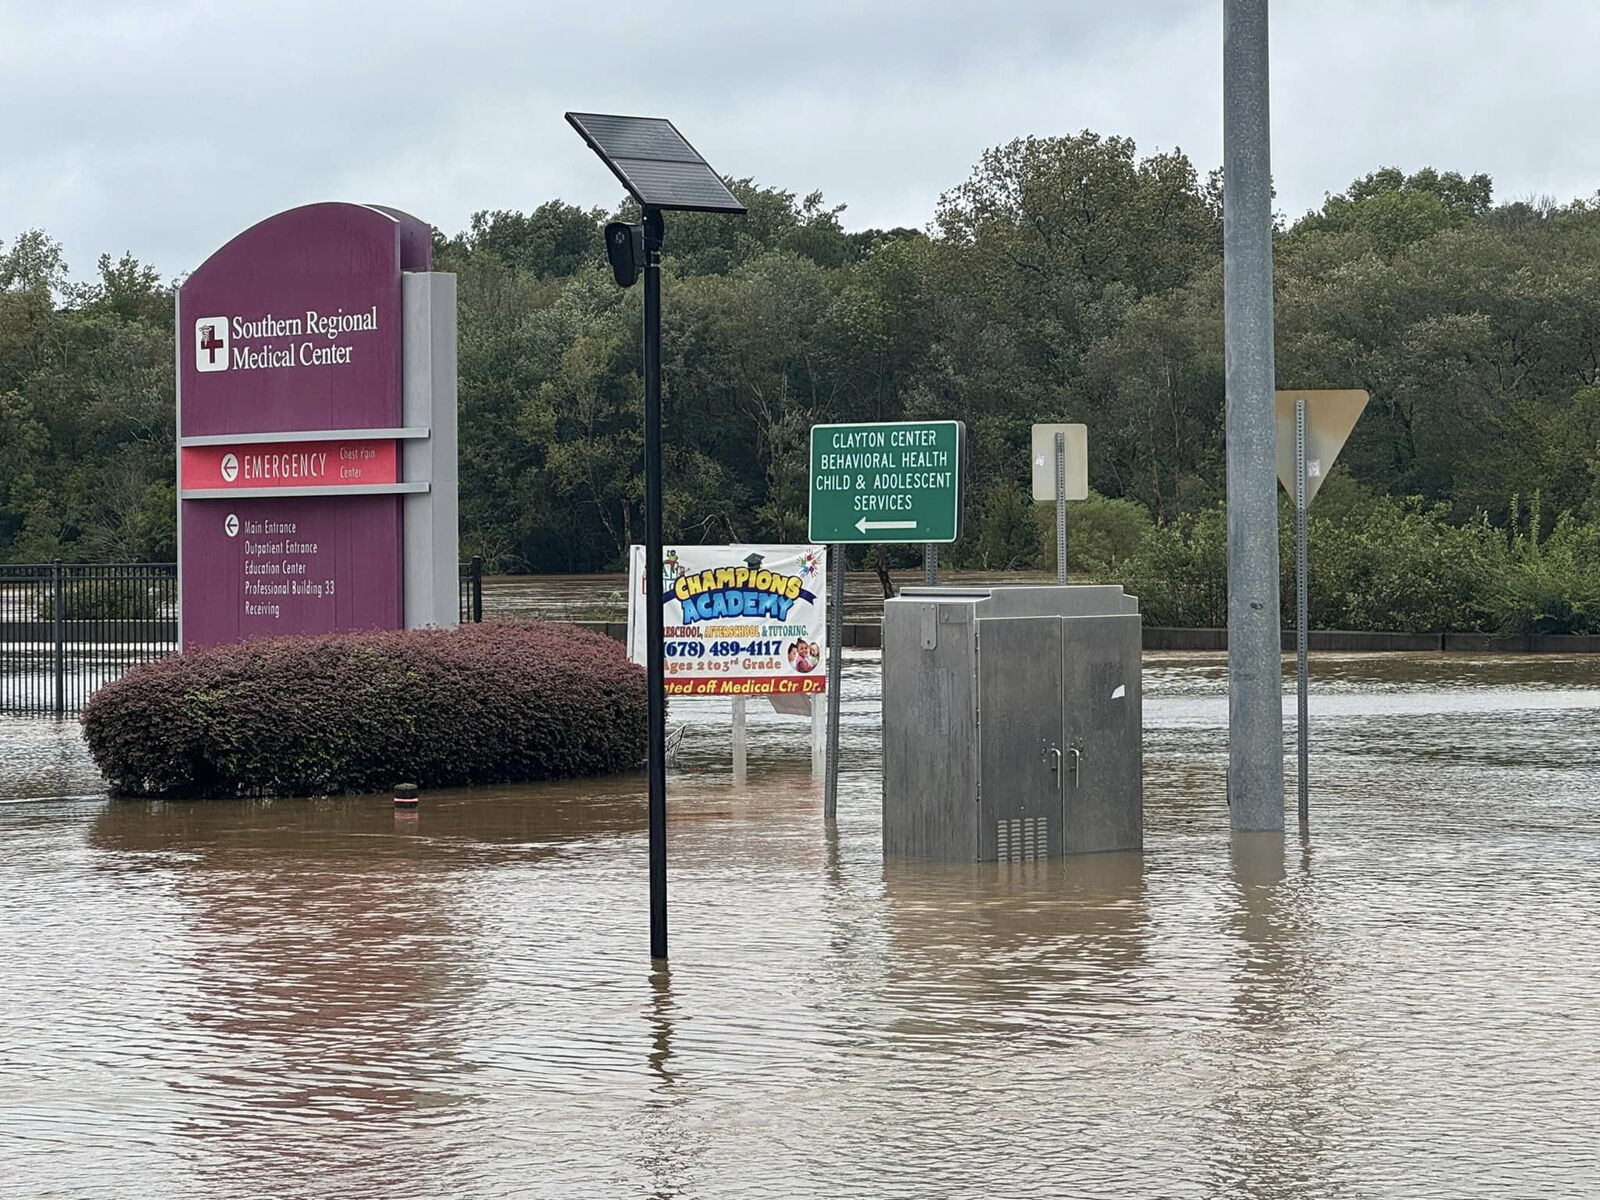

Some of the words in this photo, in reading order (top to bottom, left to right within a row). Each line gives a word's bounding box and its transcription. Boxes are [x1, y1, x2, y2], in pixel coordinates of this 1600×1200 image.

[232, 314, 301, 340] Southern
[306, 306, 378, 339] Regional
[232, 343, 296, 370] Medical
[299, 342, 353, 366] Center
[832, 432, 885, 448] CLAYTON
[890, 430, 937, 446] CENTER
[340, 447, 358, 460] Chest
[821, 453, 896, 470] BEHAVIORAL
[901, 451, 948, 468] HEALTH
[244, 453, 327, 479] EMERGENCY
[340, 465, 362, 479] Center
[816, 475, 850, 491] CHILD
[855, 474, 866, 490] &
[873, 472, 952, 489] ADOLESCENT
[854, 494, 912, 511] SERVICES
[244, 520, 262, 535] Main
[265, 519, 297, 534] Entrance
[244, 540, 283, 556] Outpatient
[285, 539, 318, 554] Entrance
[244, 560, 280, 575] Education
[282, 560, 306, 575] Center
[244, 580, 290, 595] Professional
[292, 580, 323, 598] Building
[324, 580, 335, 595] 33
[674, 566, 803, 600] CHAMPIONS
[244, 601, 280, 618] Receiving
[681, 589, 795, 625] ACADEMY
[664, 626, 704, 639] ESCHOOL,
[704, 625, 760, 638] AFTERSCHOOL
[762, 626, 768, 636] &
[709, 640, 783, 656] 489-4117
[696, 661, 705, 670] 2
[707, 660, 720, 670] to
[742, 658, 782, 671] Grade
[696, 679, 717, 693] off
[720, 680, 774, 693] Medical
[778, 679, 799, 691] Ctr
[802, 679, 822, 692] Dr.
